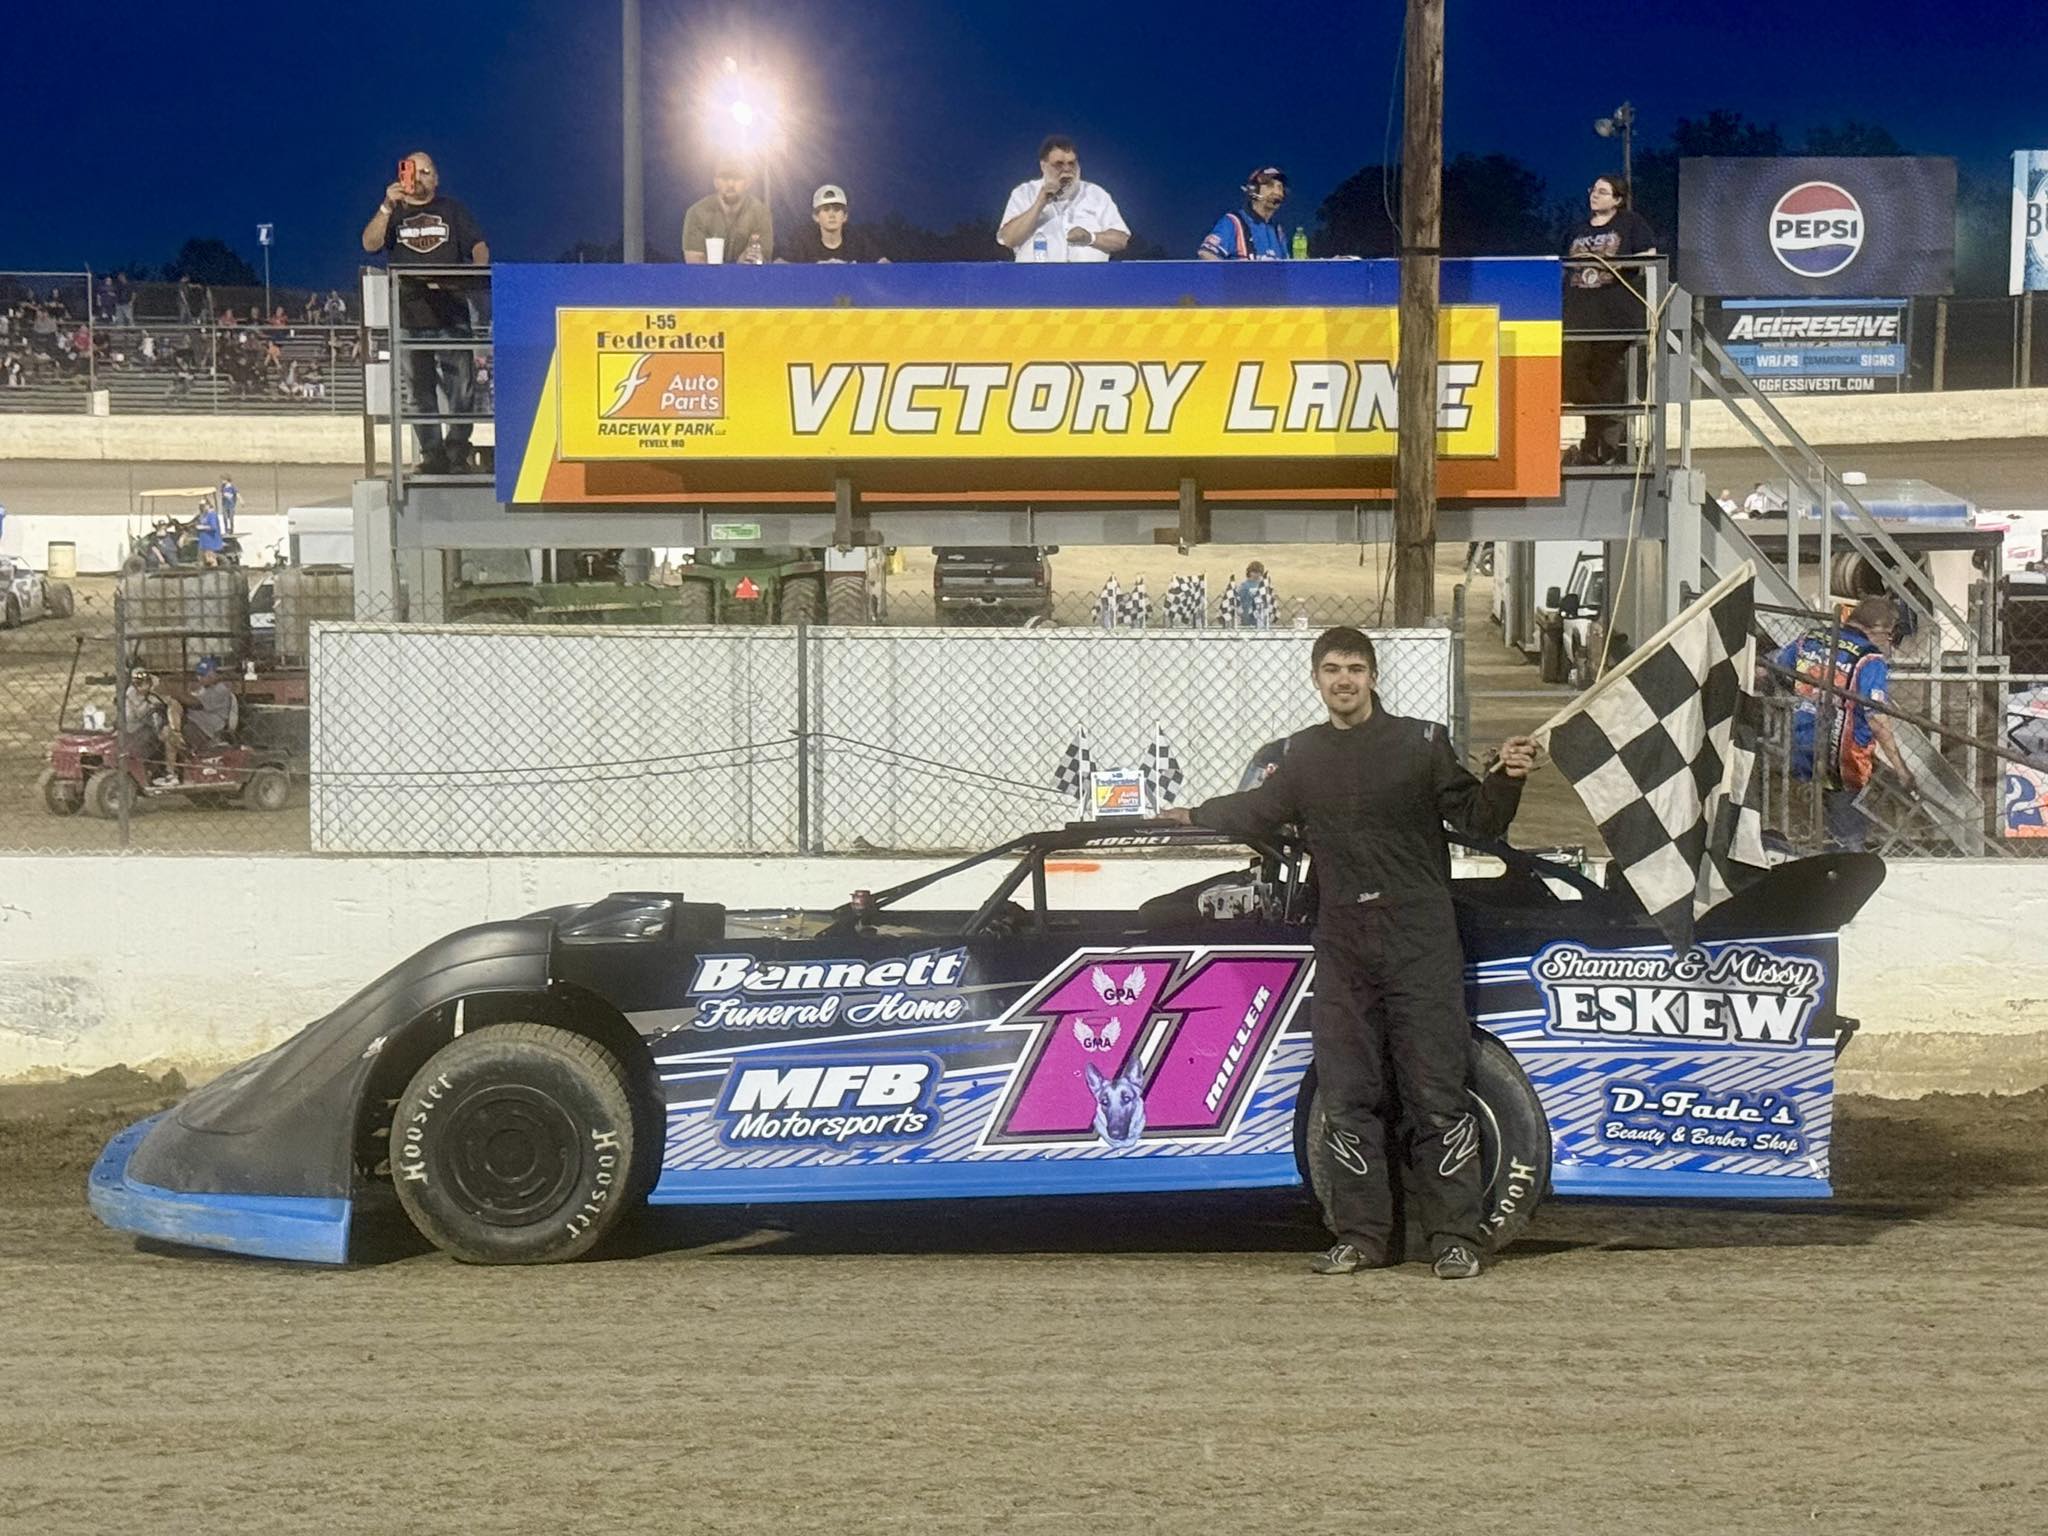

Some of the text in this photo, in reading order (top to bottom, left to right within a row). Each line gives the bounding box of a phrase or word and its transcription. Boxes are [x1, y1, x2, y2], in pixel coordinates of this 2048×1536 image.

[1776, 219, 1858, 239] PEPSI
[645, 314, 677, 329] I-55
[1727, 315, 1899, 340] AGGRESSIVE
[597, 331, 725, 349] Federated
[1860, 354, 1896, 367] SIGNS
[668, 373, 720, 391] Auto
[787, 361, 1205, 435] VICTORY
[660, 393, 720, 411] Parts
[598, 423, 671, 436] RACEWAY
[675, 423, 715, 436] PARK
[692, 953, 962, 992] Bennett
[1543, 950, 1815, 997] Shannon & Missy
[695, 992, 963, 1028] Funeral Home
[1103, 988, 1137, 1001] GPA
[1553, 985, 1812, 1044] ESKEW
[1203, 984, 1273, 1113] MILLER
[728, 1064, 930, 1111] MFB
[730, 1106, 928, 1142] Motorsports
[1610, 1087, 1796, 1125] D-Fade's
[400, 1072, 453, 1185] Hoosier
[1605, 1122, 1798, 1154] Beauty & Barber Shop
[566, 1128, 620, 1239] Hoosier
[1479, 1156, 1537, 1236] Hoosi
